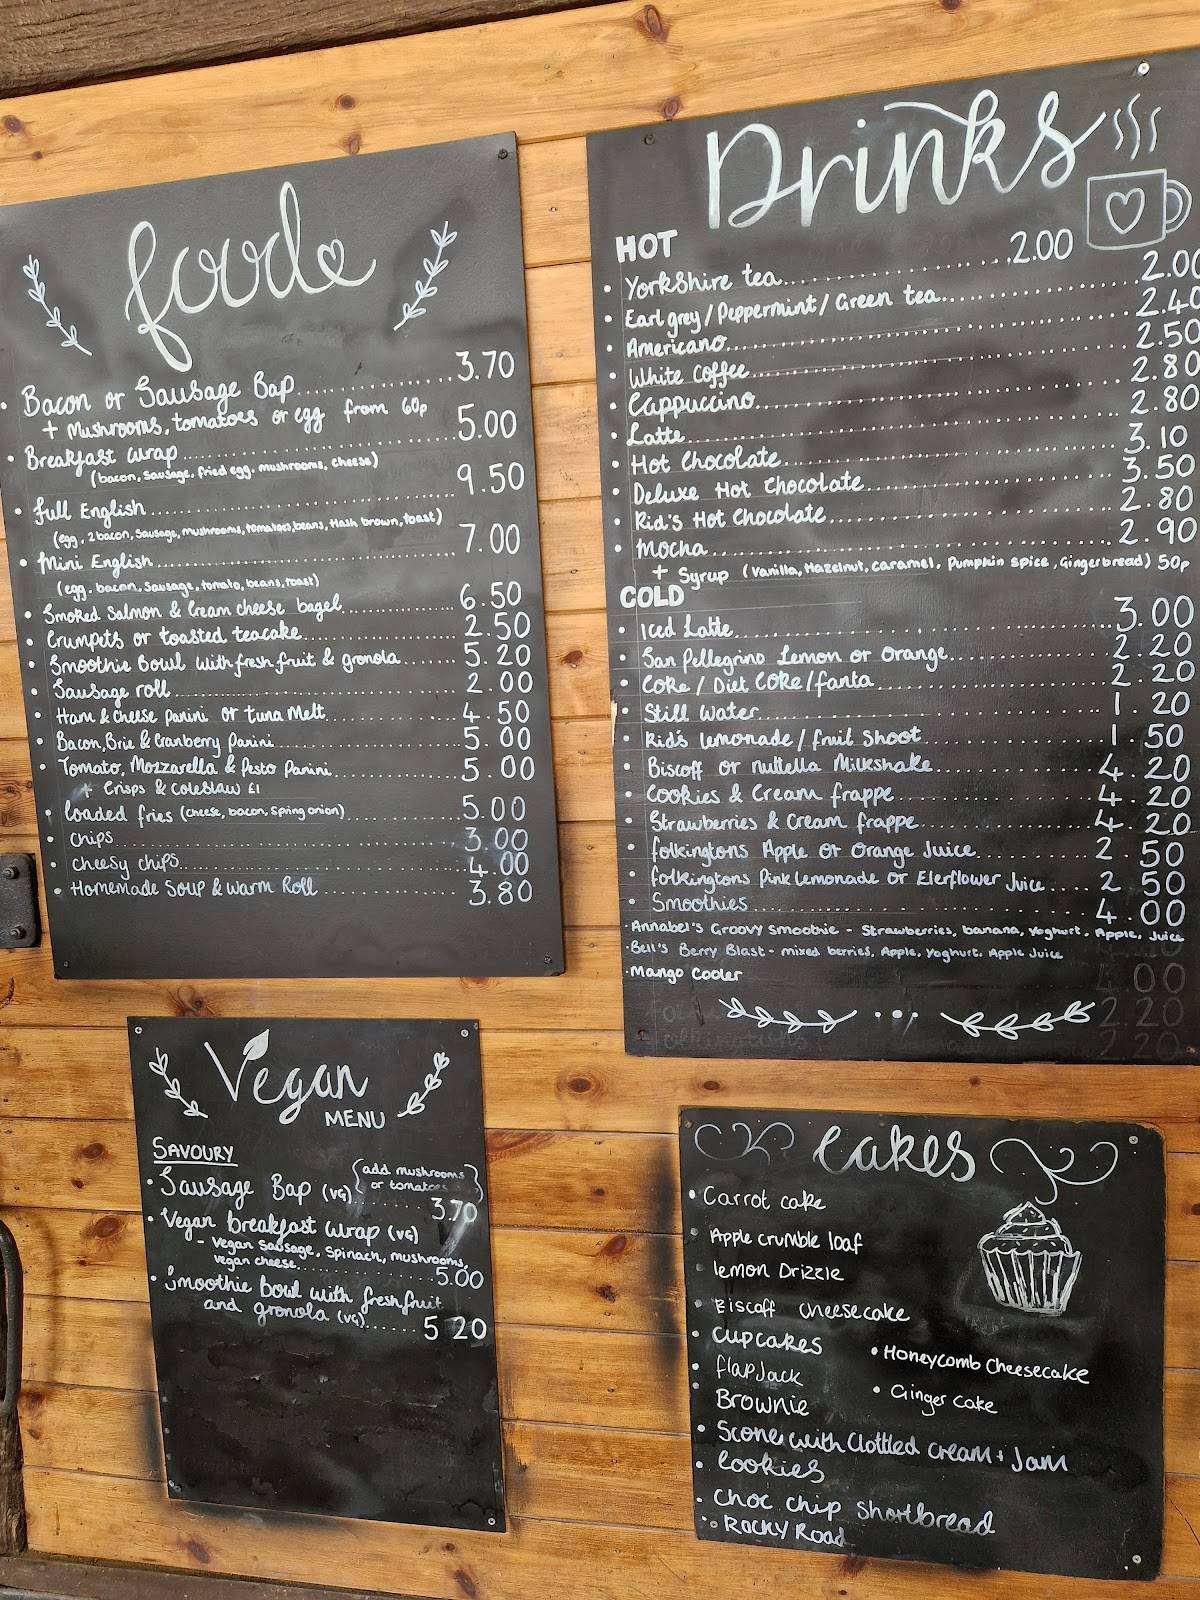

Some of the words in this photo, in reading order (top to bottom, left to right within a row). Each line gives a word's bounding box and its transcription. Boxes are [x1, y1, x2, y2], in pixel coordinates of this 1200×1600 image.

[707, 90, 1106, 229] Drinks
[616, 230, 678, 263] HOT
[742, 263, 782, 287] tea
[1010, 228, 1073, 263] 2.00
[836, 292, 893, 311] Green
[904, 284, 941, 306] tea
[627, 335, 728, 358] Americano
[22, 385, 91, 417] Bacon
[135, 376, 241, 415] Sausage
[254, 370, 294, 404] Bap
[456, 350, 514, 381] 3.70
[629, 367, 683, 389] White
[172, 409, 258, 432] tomatoes
[344, 399, 388, 423] from
[24, 445, 116, 477] Breakfast
[457, 403, 517, 441] 5.00
[626, 422, 685, 446] Latte
[631, 453, 670, 475] Hot
[682, 445, 781, 472] Chocolate
[81, 499, 146, 528] English
[457, 462, 525, 495] 9.50
[634, 482, 699, 505] Deluxe
[715, 480, 750, 499] Hot
[765, 471, 864, 495] Chocolate
[693, 509, 726, 529] Hot
[733, 503, 826, 527] Chocolate
[91, 552, 153, 578] English
[459, 523, 520, 554] 7.00
[1157, 554, 1190, 573] 50p
[460, 580, 521, 611] 6.50
[620, 584, 684, 609] COLD
[160, 626, 227, 646] toasted
[235, 620, 302, 642] teacake
[684, 614, 734, 639] Latte
[49, 654, 131, 675] Smoothie
[642, 647, 676, 669] San
[777, 644, 842, 666] Lemon
[52, 677, 129, 707] Sausage
[136, 679, 171, 698] roll
[644, 703, 689, 723] Still
[130, 754, 218, 775] Mozzarella
[752, 783, 823, 803] Cream
[831, 782, 895, 808] frappe
[649, 812, 758, 833] Strawberries
[787, 812, 848, 832] Cream
[856, 813, 919, 834] frappe
[762, 838, 808, 864] Apple
[923, 840, 976, 859] Juice
[282, 875, 318, 896] Roll
[652, 892, 748, 913] Smoothies
[679, 943, 718, 958] Berry
[631, 966, 684, 985] Mango
[204, 1041, 369, 1125] Vegan
[325, 1109, 386, 1129] MENU
[362, 1163, 391, 1176] add
[160, 1165, 254, 1210] Sausage
[271, 1172, 312, 1205] Bap
[704, 1185, 770, 1210] Carrot
[160, 1206, 216, 1242] Vegan
[710, 1227, 752, 1248] Apple
[435, 1266, 484, 1290] 5.00
[780, 1262, 844, 1282] Drizzle
[204, 1297, 242, 1313] and
[884, 1344, 981, 1370] Honeycomb
[716, 1388, 810, 1417] Brownie
[890, 1384, 946, 1416] Ginger
